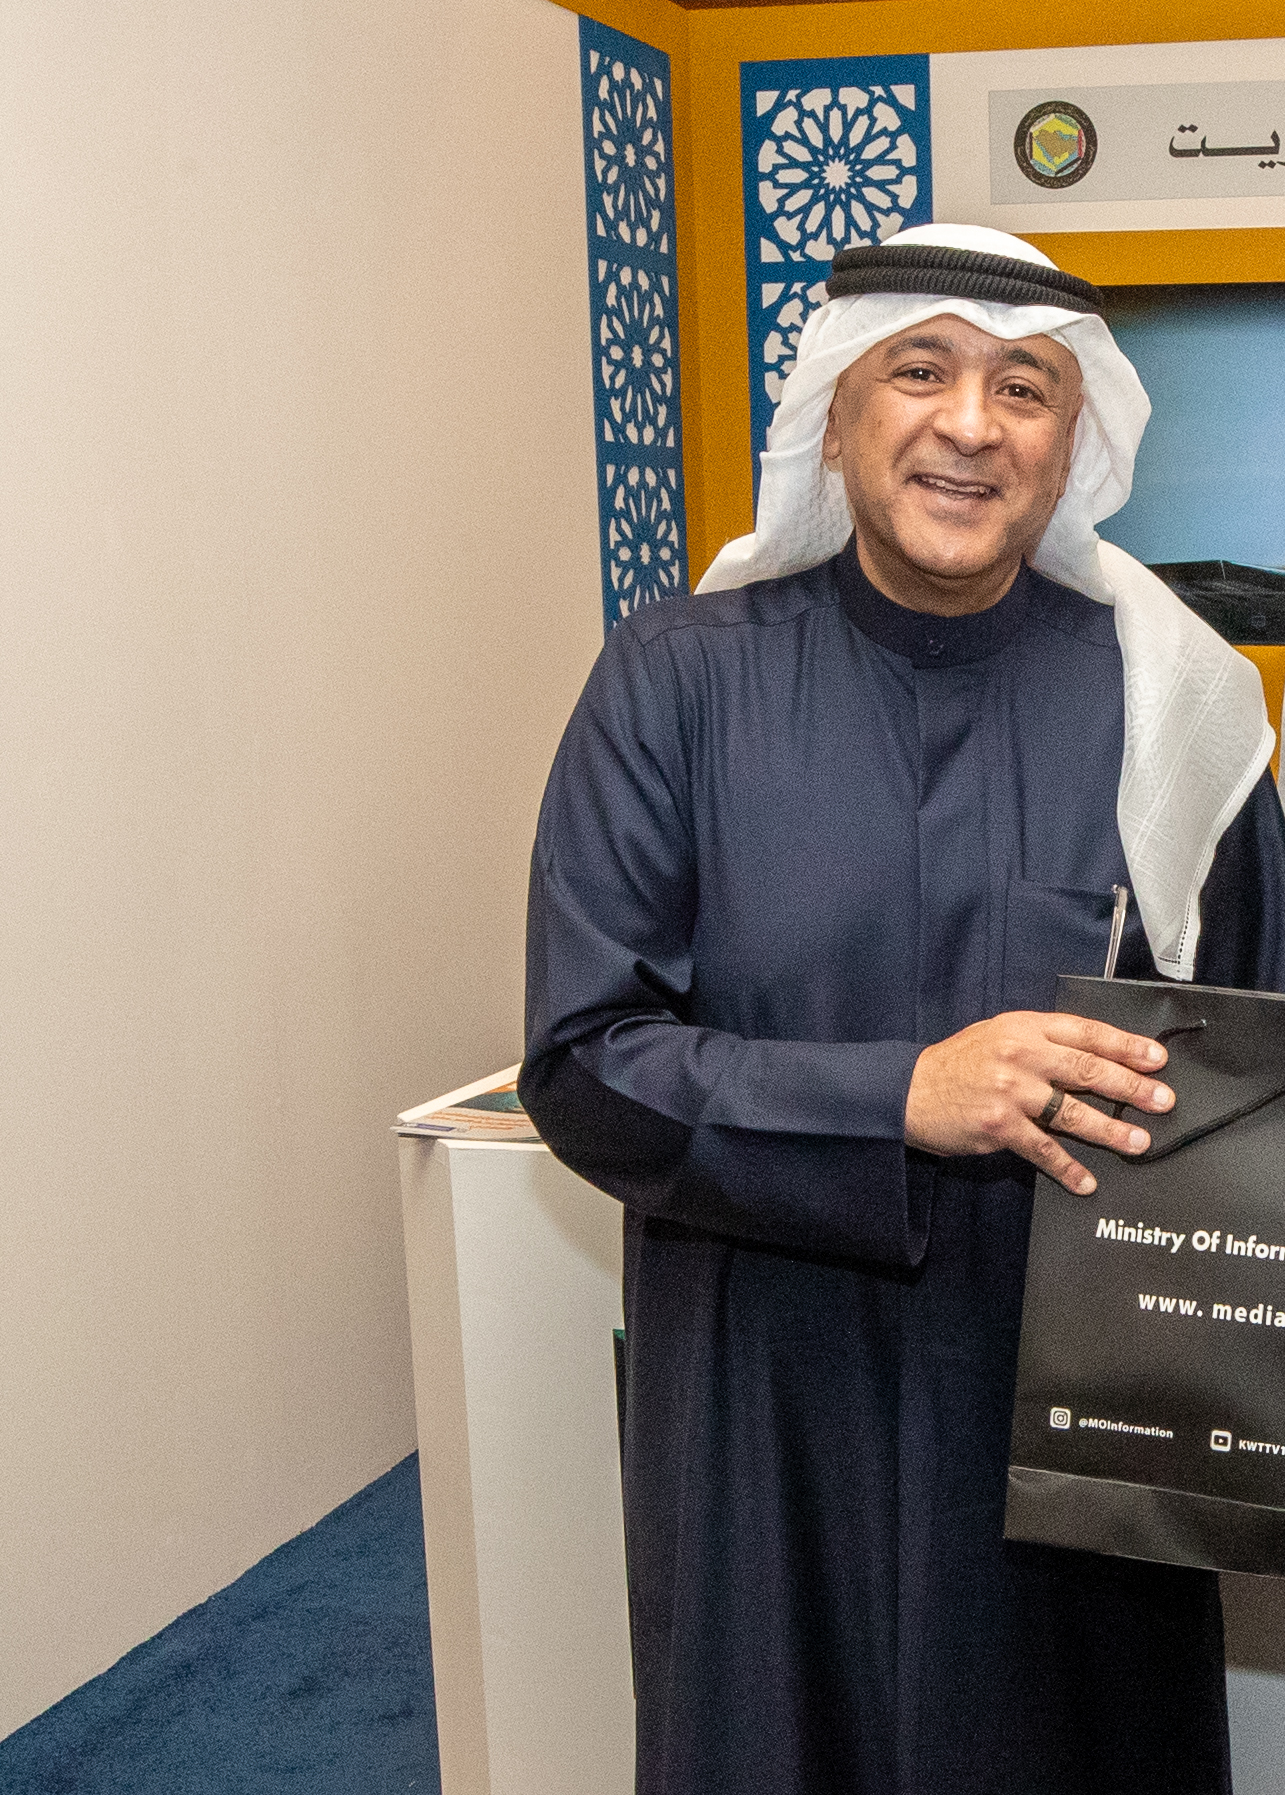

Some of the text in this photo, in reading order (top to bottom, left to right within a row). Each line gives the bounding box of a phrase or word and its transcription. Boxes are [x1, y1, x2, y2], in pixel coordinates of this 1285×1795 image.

[1095, 1217, 1186, 1254] Ministry
[1191, 1229, 1221, 1253] Of
[1138, 1293, 1204, 1318] www.
[1078, 1417, 1174, 1439] @MOInformation
